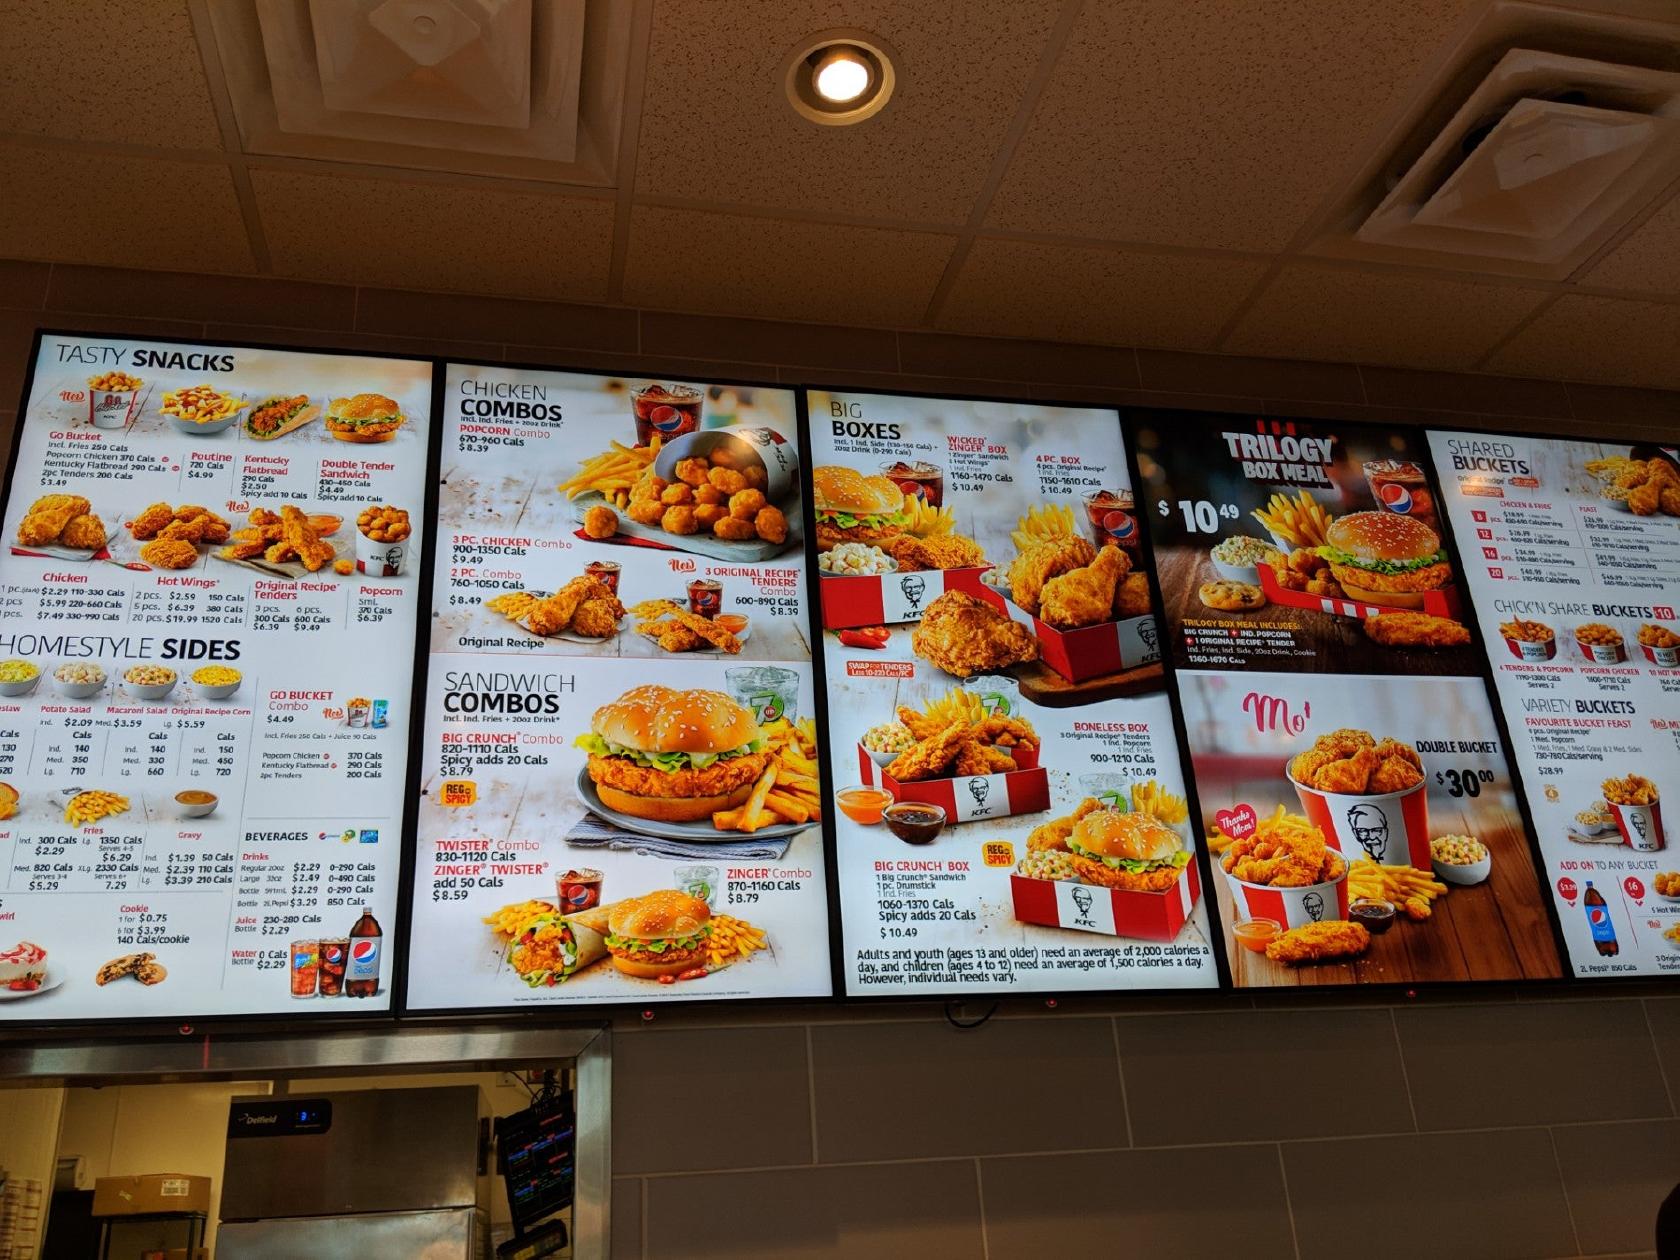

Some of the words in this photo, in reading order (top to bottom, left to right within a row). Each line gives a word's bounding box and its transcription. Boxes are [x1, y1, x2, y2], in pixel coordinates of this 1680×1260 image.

[57, 344, 126, 365] TASTY
[132, 349, 235, 372] SNACKS
[461, 380, 547, 400] CHICKEN
[461, 399, 562, 421] COMBOS
[831, 401, 862, 418] BIG
[460, 424, 510, 435] POPCORN
[514, 427, 550, 438] Combo
[832, 421, 900, 440] BOXES
[49, 431, 63, 440] Go
[66, 432, 102, 441] Bucket
[503, 438, 524, 446] Cals
[988, 446, 1007, 454] BOX
[1222, 432, 1332, 463] TRILOGY
[1448, 440, 1514, 458] SHARED
[47, 451, 82, 460] Popcorn
[84, 452, 118, 461] Chicken
[192, 452, 232, 462] Poutine
[245, 455, 289, 465] Kentucky
[322, 460, 358, 470] Double
[361, 461, 395, 471] Tender
[1453, 456, 1529, 474] BUCKETS
[188, 471, 213, 479] $4.99
[243, 466, 288, 475] Flatbread
[320, 470, 370, 479] Sandwich
[1242, 461, 1280, 480] BOX
[1281, 464, 1329, 483] MEAL
[995, 474, 1013, 482] Cals
[482, 537, 530, 546] CHICKEN
[535, 539, 572, 549] Combo
[714, 568, 760, 577] ORIGINAL
[43, 573, 88, 583] Chicken
[157, 577, 177, 585] Hot
[181, 577, 217, 589] Wings
[751, 578, 796, 587] TENDERS
[255, 581, 297, 591] Original
[360, 586, 403, 596] Popcorn
[42, 587, 68, 596] $2.29
[254, 591, 297, 600] Tenders
[1494, 600, 1546, 614] CHICK'N
[1549, 602, 1590, 616] SHARE
[1592, 604, 1652, 618] BUCKETS
[459, 637, 503, 648] Original
[507, 638, 544, 649] Recipe
[161, 638, 239, 660] SIDES
[444, 672, 575, 692] SANDWICH
[270, 691, 286, 699] GO
[289, 691, 333, 700] BUCKET
[269, 701, 308, 711] Combo
[444, 692, 559, 714] COMBOS
[1521, 698, 1571, 712] VARIETY
[1576, 700, 1635, 713] BUCKETS
[267, 714, 294, 723] $4.49
[1525, 718, 1572, 726] FAVOURITE
[1574, 719, 1605, 727] BUCKET
[1608, 720, 1632, 728] FEAST
[1074, 723, 1125, 731] BONELESS
[1128, 724, 1148, 732] BOX
[442, 733, 462, 743] BIG
[522, 734, 563, 744] Combo
[442, 744, 491, 753] 820-1110
[495, 744, 518, 753] Cals
[1416, 741, 1456, 753] DOUBLE
[1458, 742, 1497, 753] BUCKET
[441, 755, 472, 767] Spicy
[476, 755, 503, 764] adds
[508, 756, 520, 764] 20
[524, 756, 548, 765] Cals
[1091, 754, 1131, 763] 900-1210
[1134, 755, 1155, 763] Cals
[972, 808, 991, 816] KFC
[84, 827, 104, 835] Fries
[179, 831, 202, 840] Gravy
[245, 832, 308, 841] BEVERAGES
[497, 840, 540, 850] Combo
[874, 861, 893, 871] BIG
[948, 861, 970, 871] BOX
[1560, 862, 1578, 870] ADD
[1582, 862, 1594, 870] ON
[1596, 861, 1607, 869] TO
[1609, 861, 1624, 869] ANY
[1627, 861, 1658, 869] BUCKET
[773, 868, 812, 878] Combo
[120, 904, 149, 913] Cookie
[236, 916, 257, 924] Juice
[302, 915, 321, 923] Cals
[117, 936, 133, 944] 140
[857, 949, 889, 960] Adults
[892, 949, 911, 959] and
[914, 949, 944, 962] youth
[947, 947, 973, 962] (ages
[976, 949, 986, 958] 13
[989, 948, 1006, 958] and
[1010, 947, 1038, 959] older)
[1042, 947, 1065, 957] need
[1069, 948, 1080, 957] an
[1083, 949, 1121, 958] average
[1124, 947, 1133, 956] of
[1135, 947, 1161, 957] 2,000
[1164, 946, 1200, 955] calories
[858, 962, 878, 974] day,
[881, 962, 899, 971] and
[903, 960, 944, 971] children
[948, 959, 973, 973] (ages
[985, 960, 995, 969] to
[1014, 959, 1038, 970] need
[1042, 960, 1053, 968] an
[1057, 960, 1095, 971] average
[1097, 958, 1107, 967] of
[1110, 958, 1134, 970] 1,500
[1137, 957, 1173, 967] calories
[1185, 957, 1203, 969] day.
[859, 973, 906, 985] However,
[908, 972, 957, 983] individual
[960, 972, 990, 982] needs
